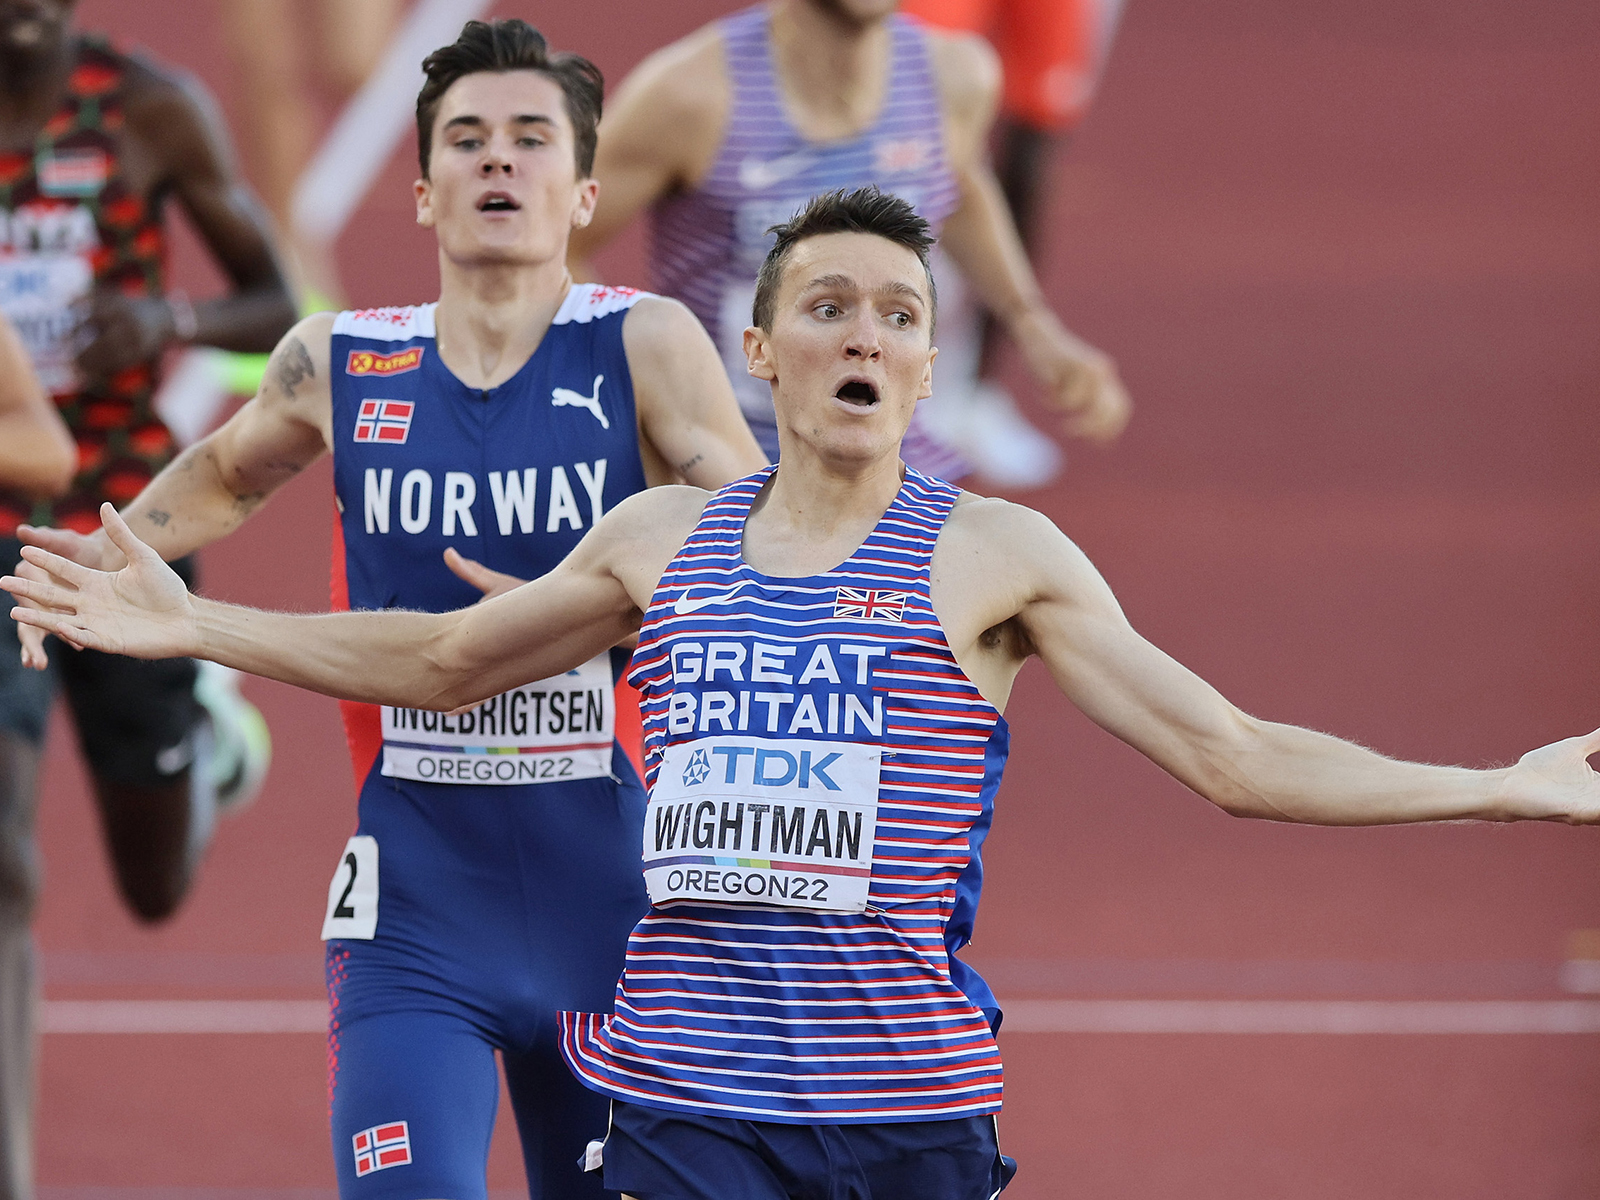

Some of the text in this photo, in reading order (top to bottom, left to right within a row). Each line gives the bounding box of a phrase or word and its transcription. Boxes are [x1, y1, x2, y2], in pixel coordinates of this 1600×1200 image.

[375, 352, 416, 371] EXTRA
[364, 458, 607, 537] NORWAY
[670, 641, 886, 685] GREAT
[668, 690, 883, 737] BRITAIN
[417, 757, 574, 781] OREGON22
[712, 746, 844, 792] TDK
[655, 800, 862, 860] WIGHTMAN
[333, 852, 358, 919] 2
[667, 869, 829, 902] OREGON22
